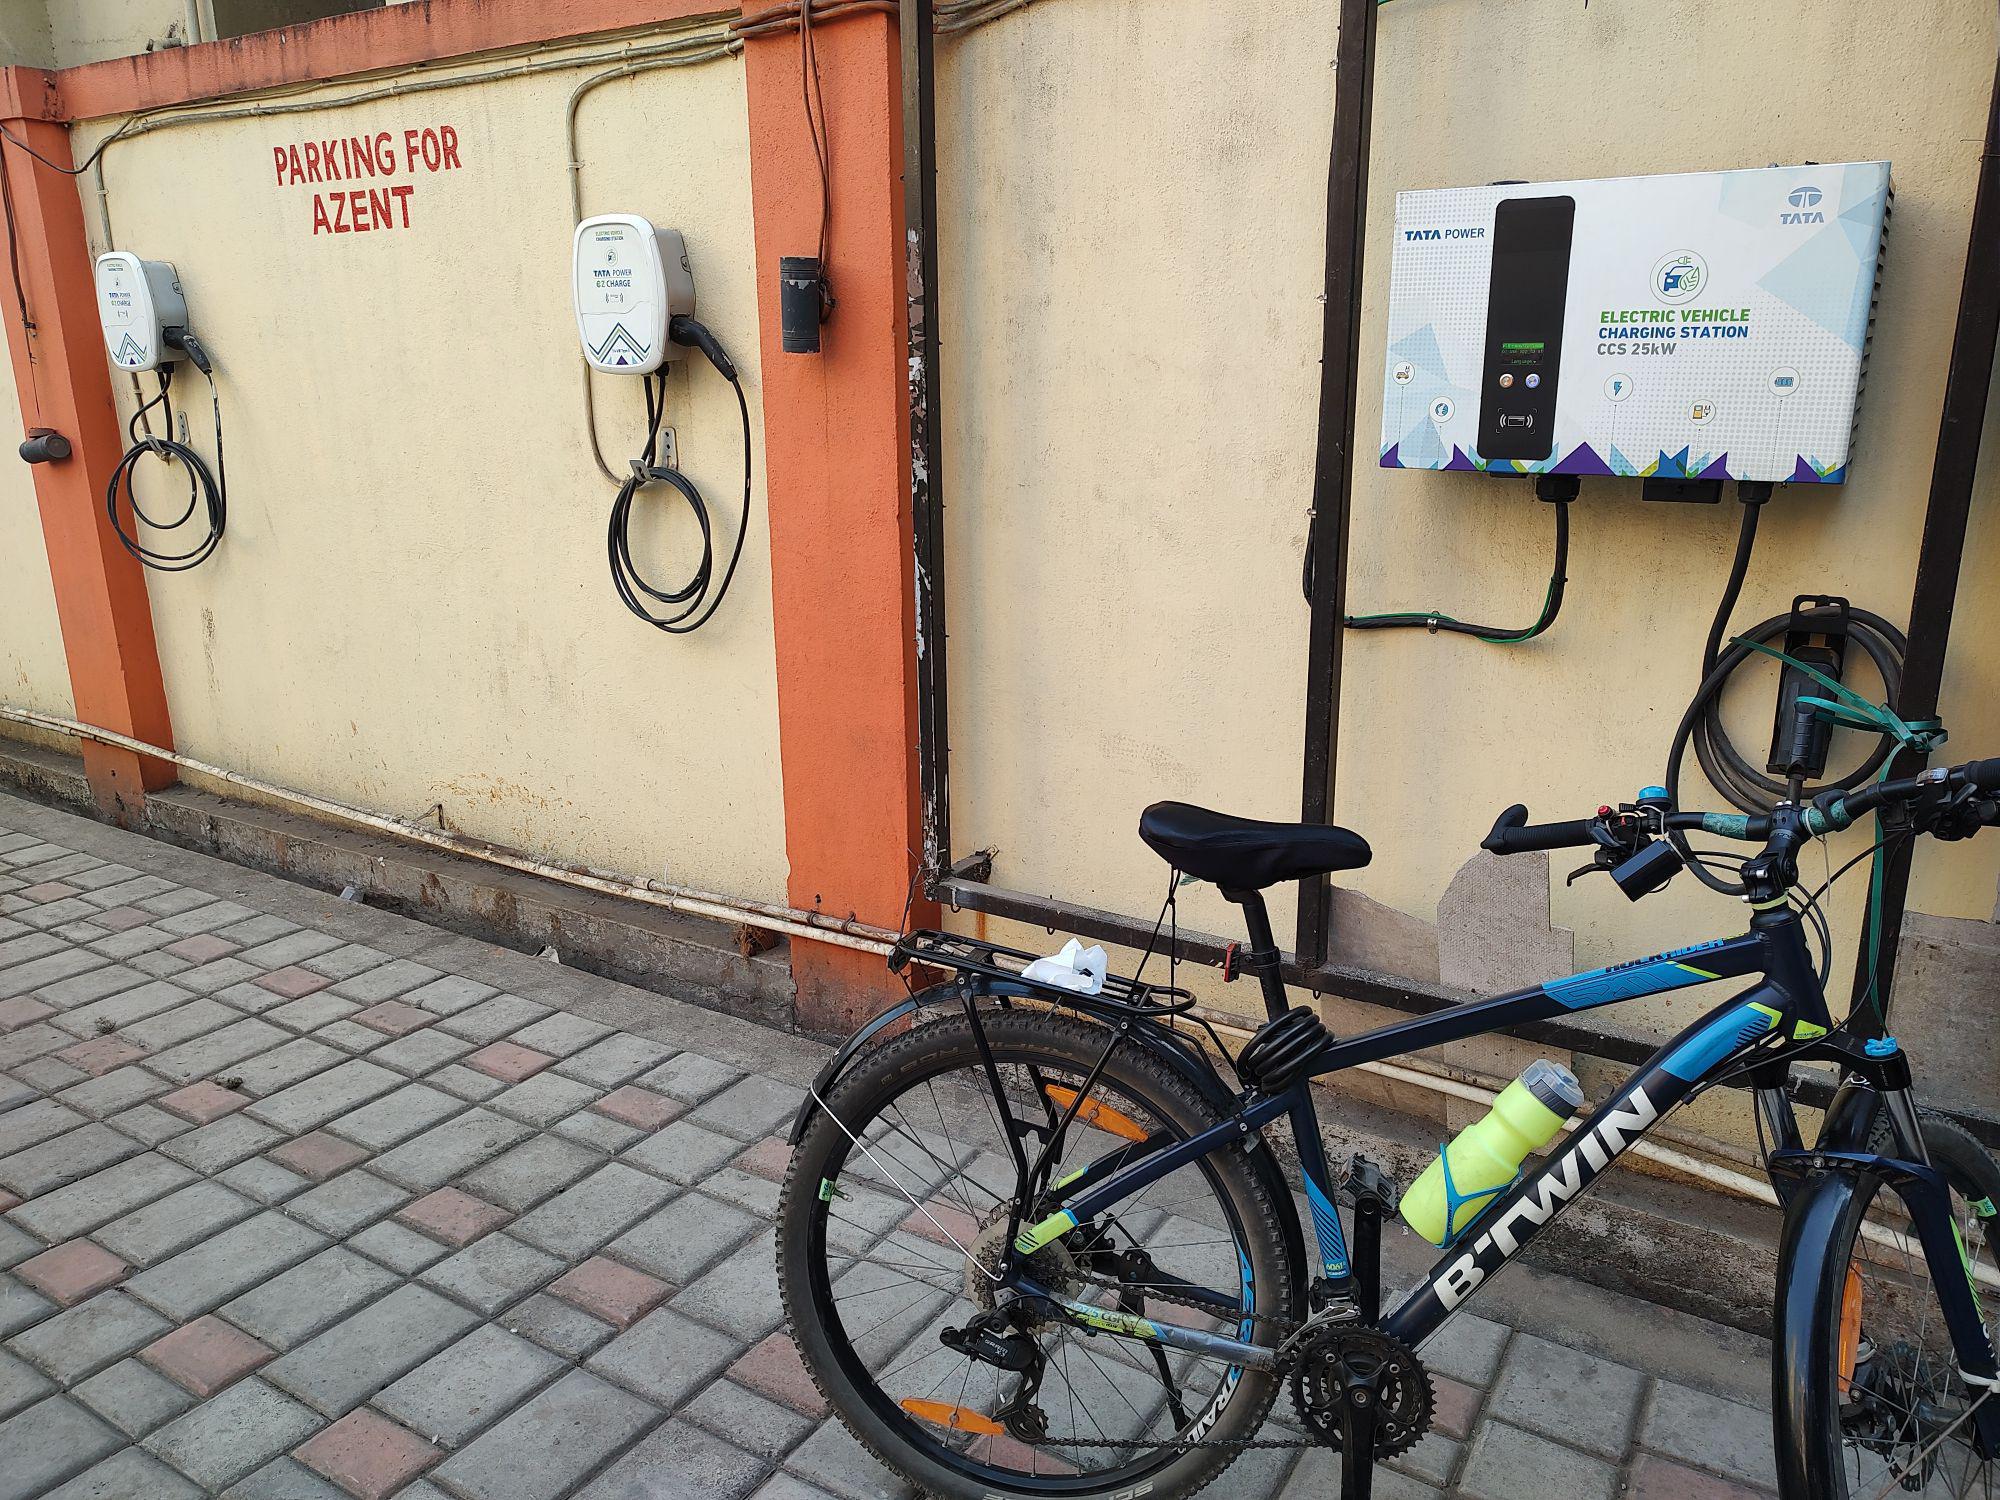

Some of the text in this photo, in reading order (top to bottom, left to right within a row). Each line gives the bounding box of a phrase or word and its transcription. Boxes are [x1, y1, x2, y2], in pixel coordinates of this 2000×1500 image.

[273, 125, 463, 187] PARKING FOR
[313, 184, 415, 236] AZENT
[1780, 211, 1825, 225] TATA
[1404, 227, 1486, 242] TATA POWER
[593, 268, 632, 278] TATA POWER
[606, 279, 632, 288] CHARGE
[1600, 308, 1751, 324] ELECTRIC VEHICLE
[1598, 325, 1749, 339] CHARGING STATION
[1597, 343, 1677, 355] CCS 25kW
